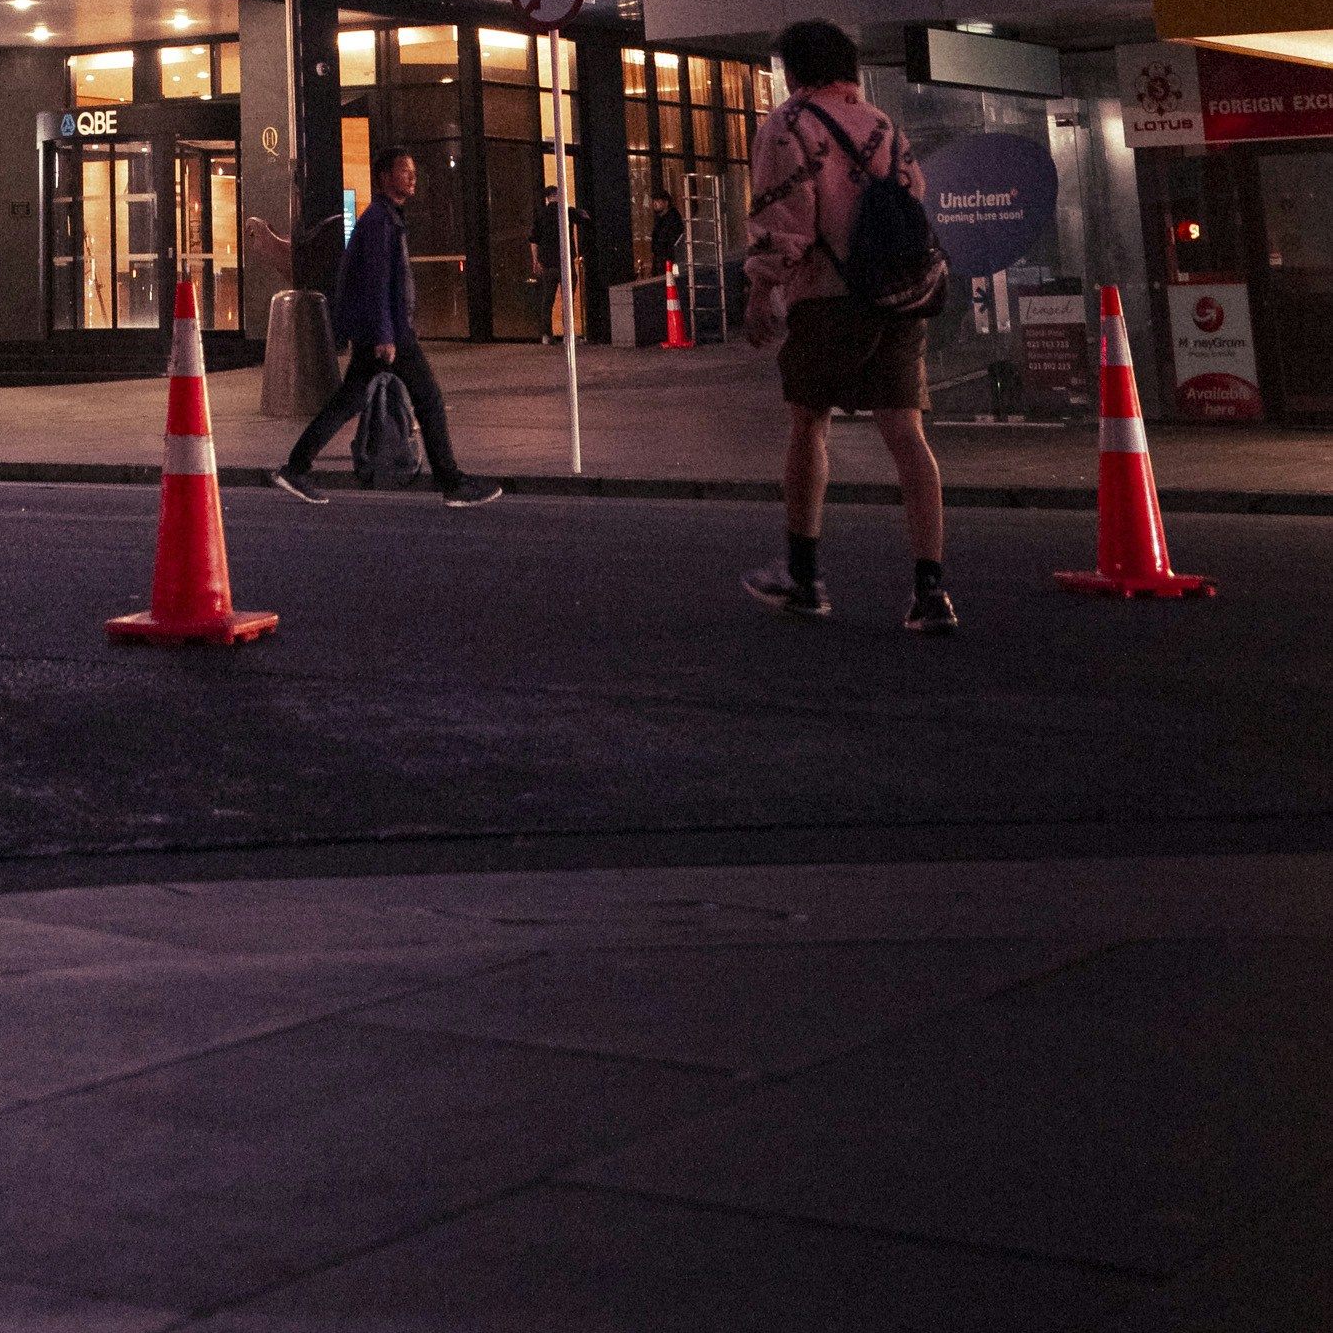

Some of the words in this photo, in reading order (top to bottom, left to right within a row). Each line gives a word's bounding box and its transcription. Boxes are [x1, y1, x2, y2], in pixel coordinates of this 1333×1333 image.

[1208, 96, 1284, 116] FOREIGN
[76, 110, 118, 136] QBE
[1133, 118, 1194, 132] LOTUS
[939, 189, 1012, 209] Unichem
[936, 211, 975, 225] Opening
[998, 209, 1024, 221] soon!
[1178, 337, 1246, 349] MneyGram
[1186, 386, 1251, 400] Available
[1204, 403, 1237, 415] here
